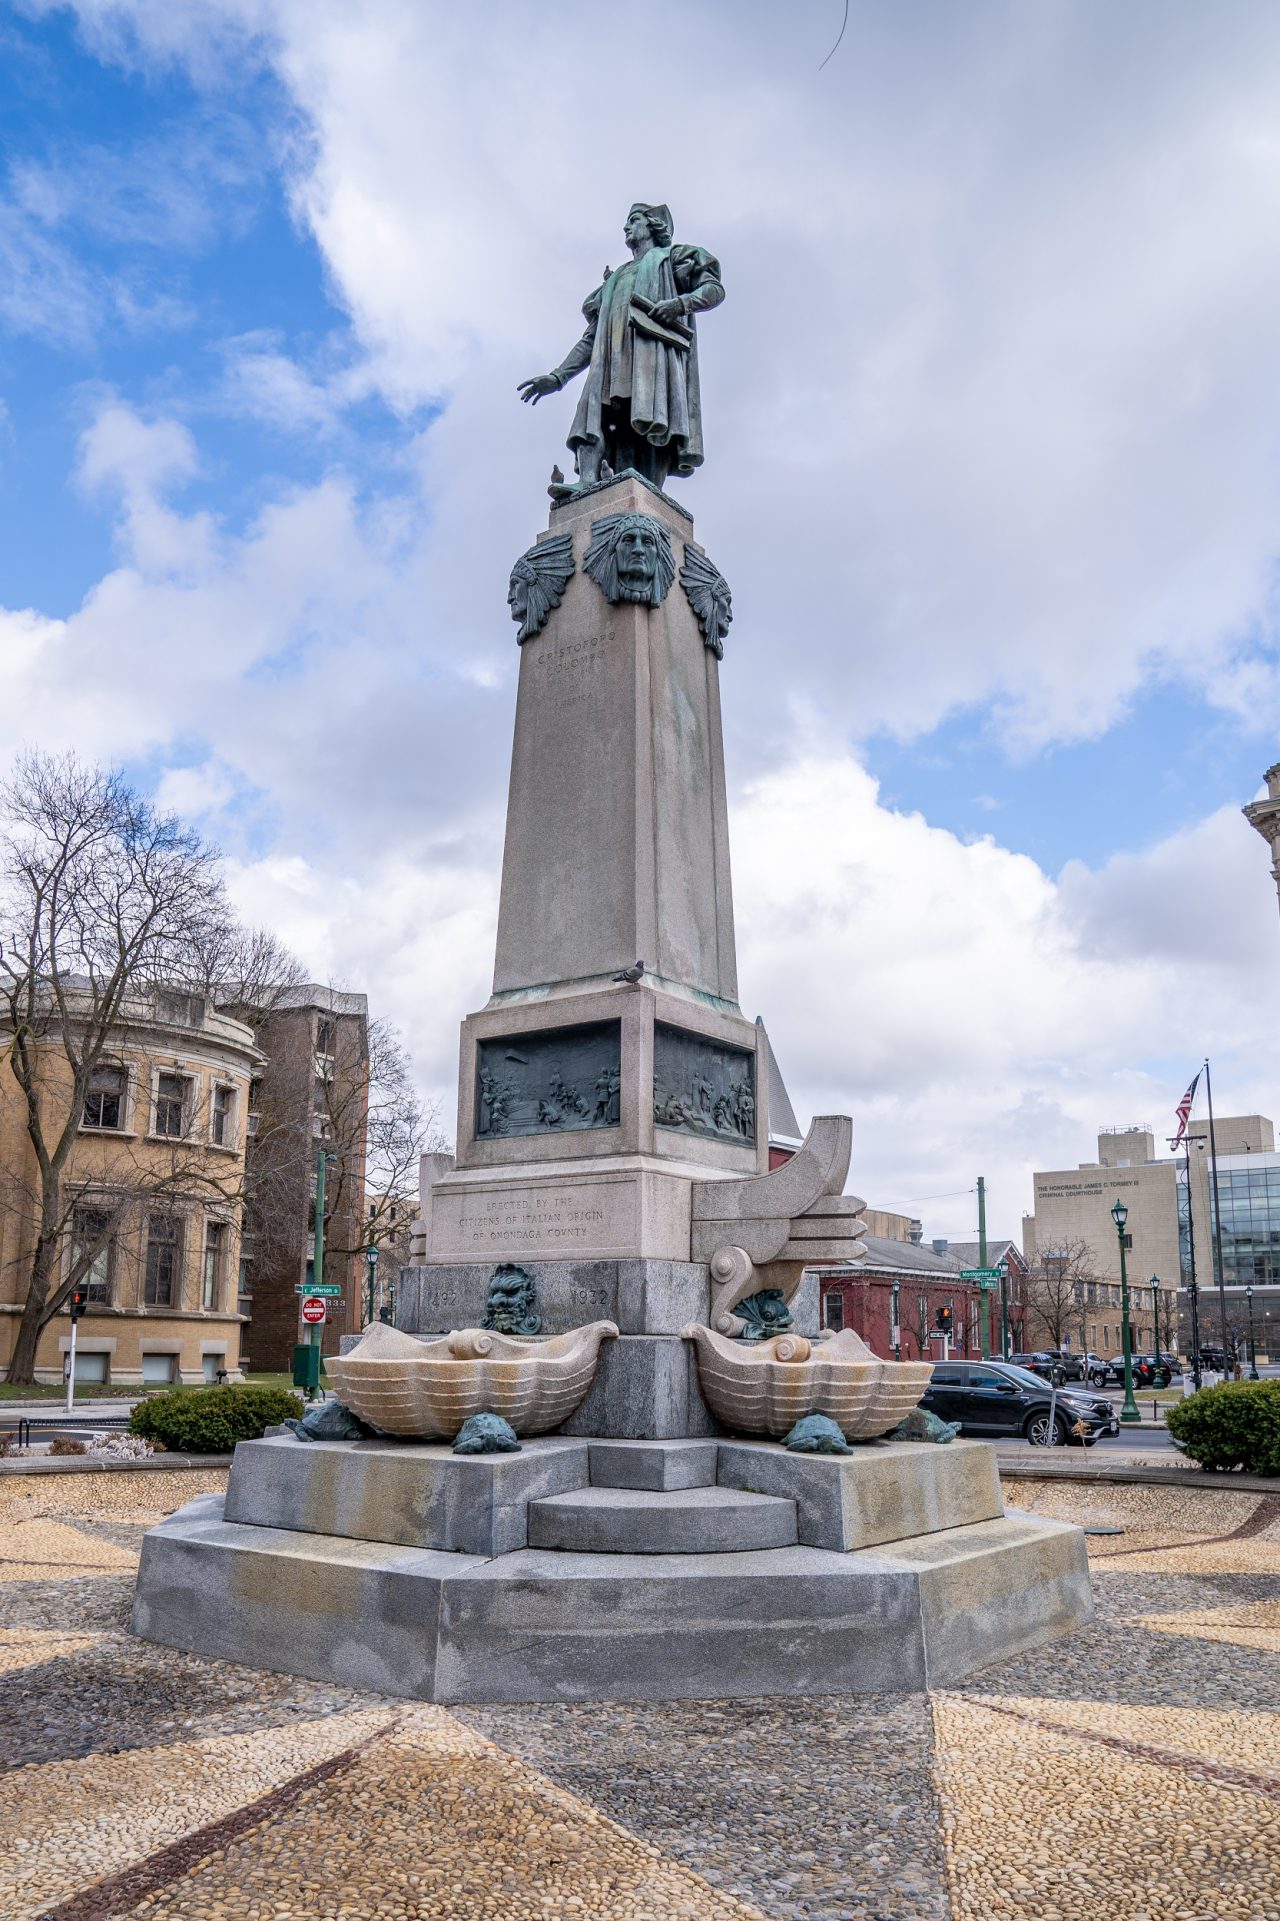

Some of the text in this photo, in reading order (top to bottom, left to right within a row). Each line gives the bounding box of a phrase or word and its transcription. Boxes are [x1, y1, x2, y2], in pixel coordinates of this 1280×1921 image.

[538, 631, 616, 665] CRISTOFORO
[547, 650, 606, 677] COLOMBO
[1065, 1189, 1103, 1197] COURTHOUSE
[486, 1198, 572, 1211] ERECTED BY THE
[459, 1211, 603, 1228] CITIZENS OF ITALIAN ORIGIN
[472, 1232, 484, 1241] OF
[490, 1230, 542, 1240] ONONDAGA
